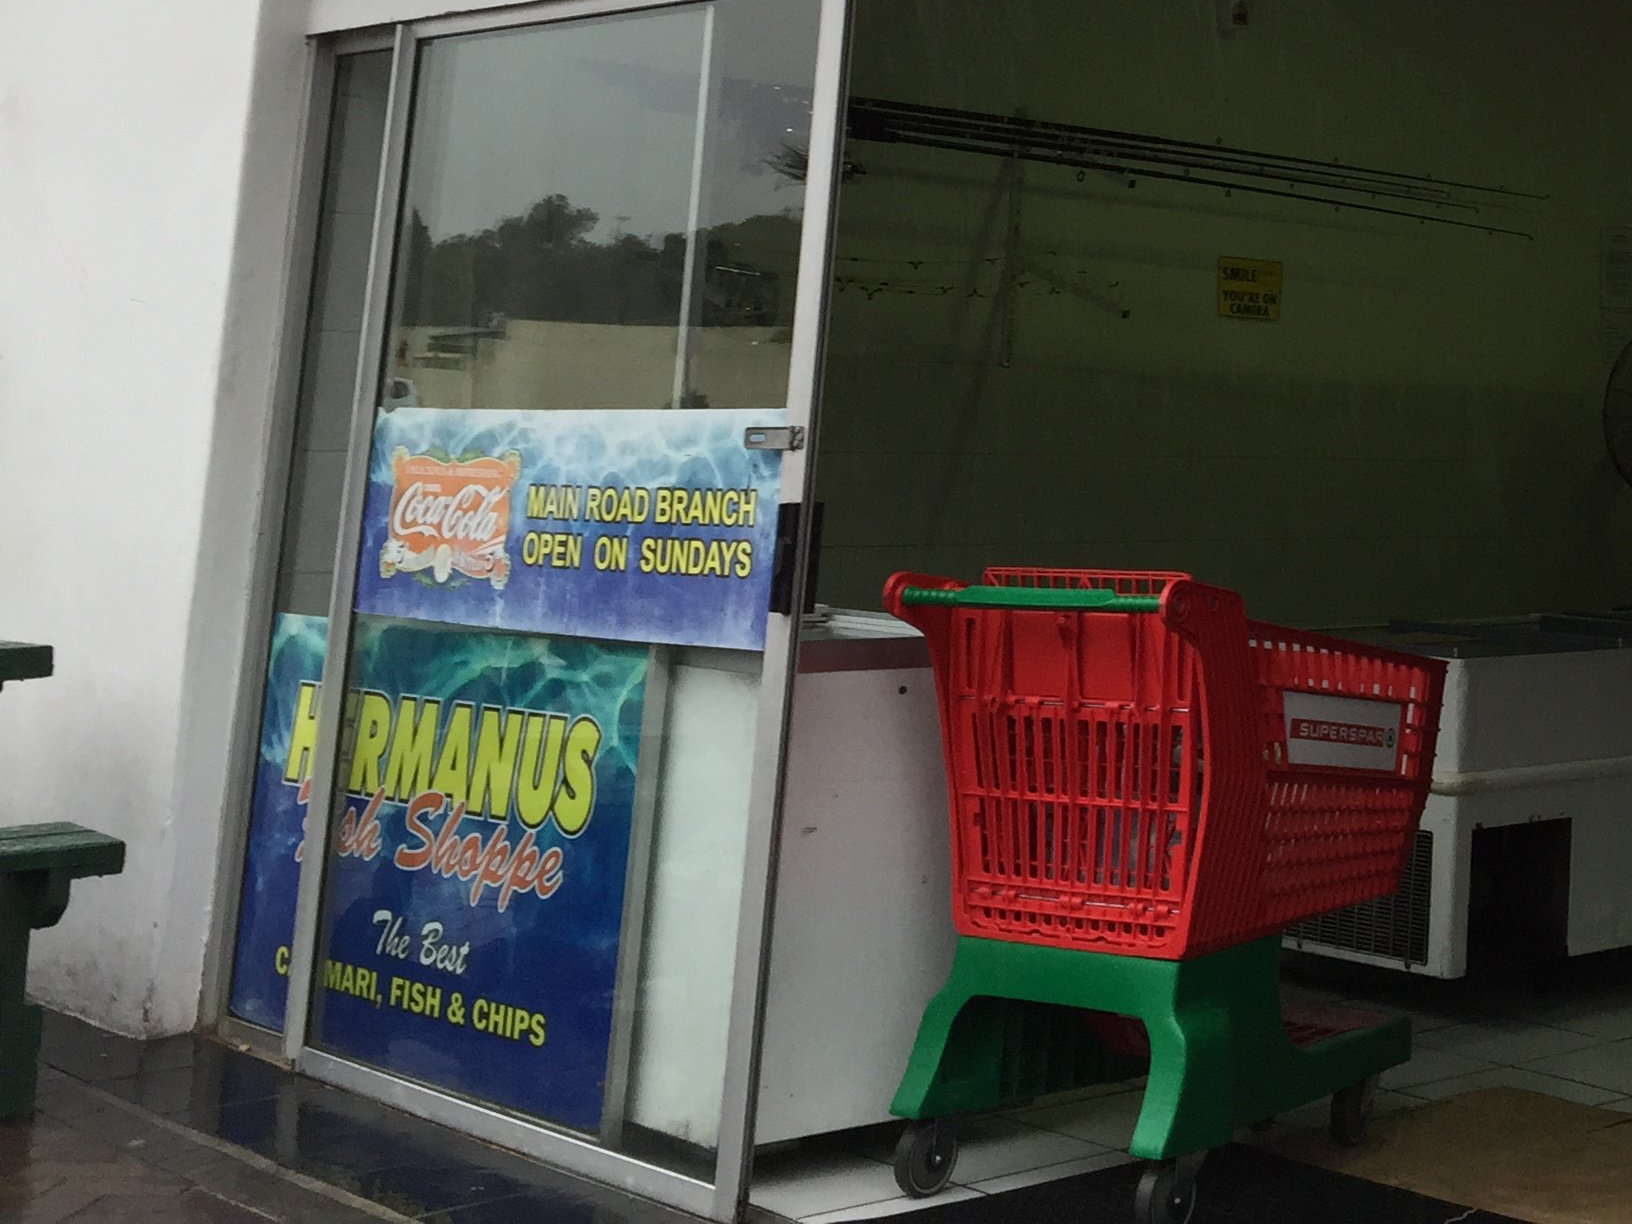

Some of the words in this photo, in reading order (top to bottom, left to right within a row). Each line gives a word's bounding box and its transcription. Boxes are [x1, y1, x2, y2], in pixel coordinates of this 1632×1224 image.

[526, 483, 581, 521] MAIN
[584, 485, 650, 524] ROAD
[654, 487, 758, 527] BRANCH
[522, 530, 583, 568] OPEN
[593, 534, 628, 572] ON
[639, 536, 752, 579] SUNDAYS
[1299, 722, 1385, 743] SUPERSPAR
[395, 789, 563, 913] Shoppe
[372, 909, 411, 960] The
[419, 921, 470, 974] Best
[389, 976, 442, 1019] FISH
[447, 992, 466, 1025] &
[472, 998, 546, 1047] CHIPS
